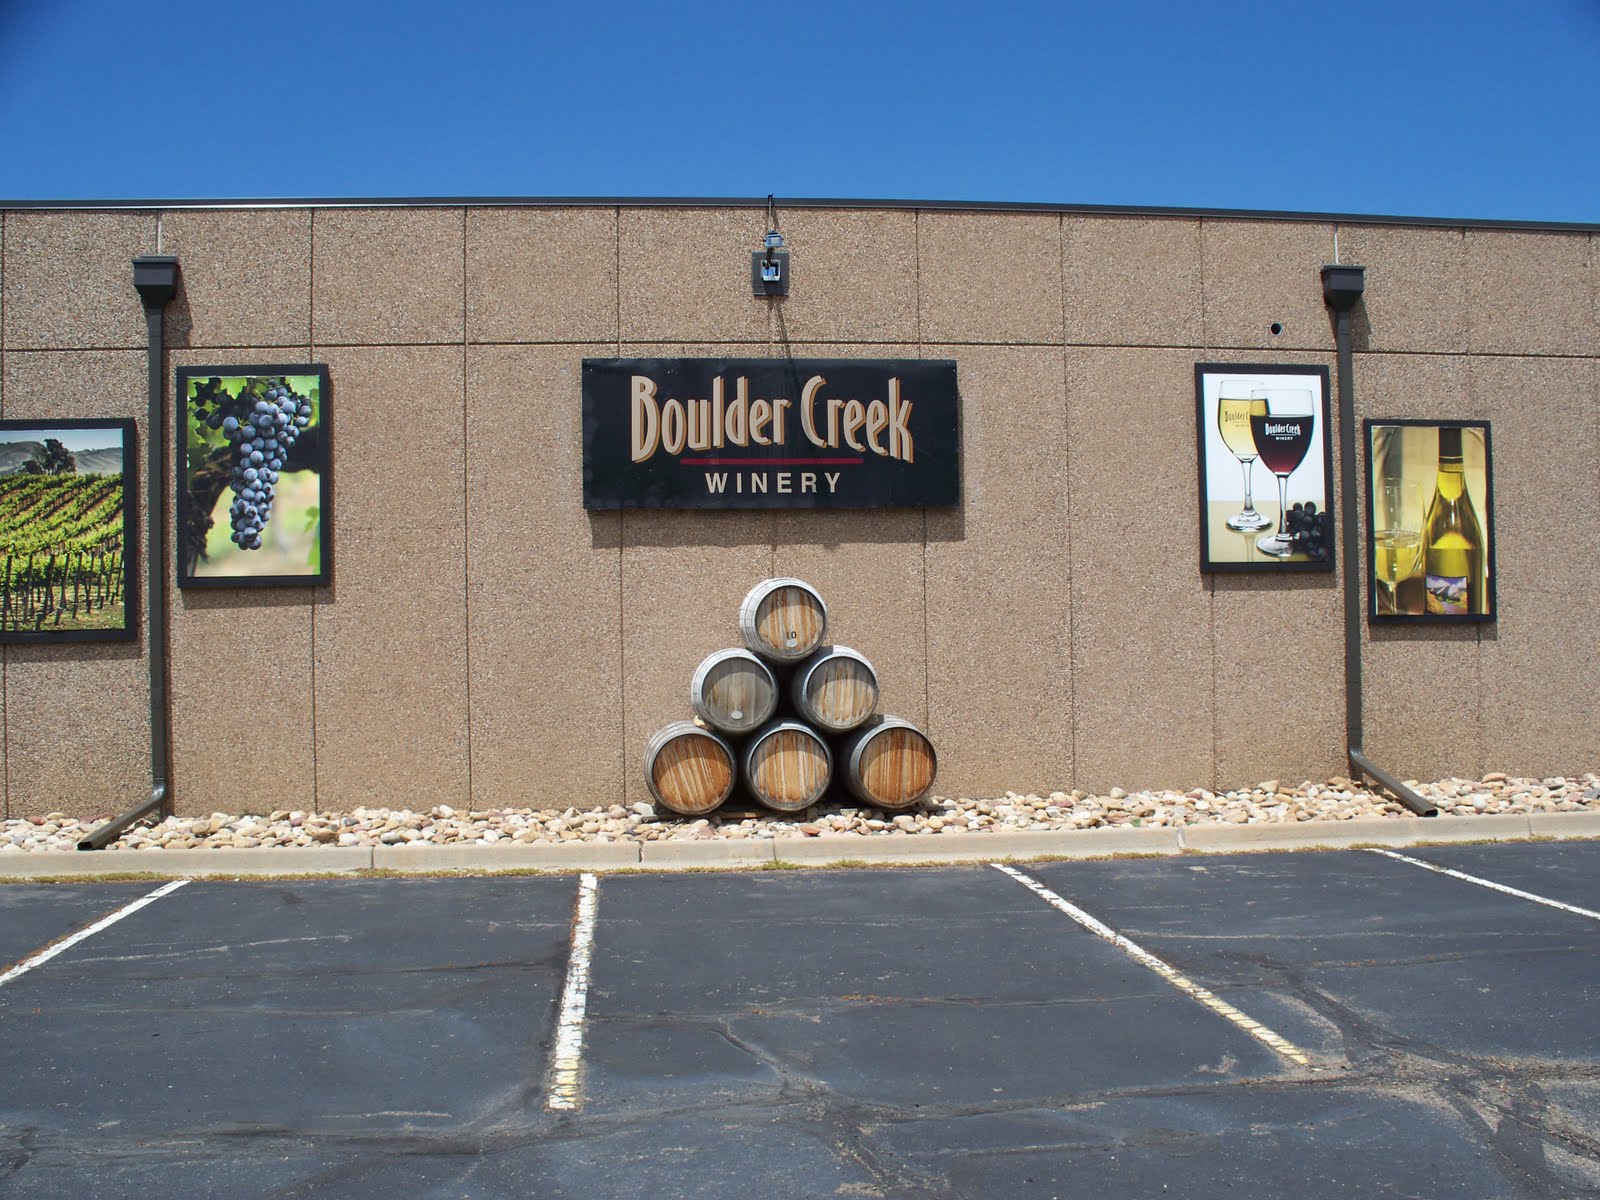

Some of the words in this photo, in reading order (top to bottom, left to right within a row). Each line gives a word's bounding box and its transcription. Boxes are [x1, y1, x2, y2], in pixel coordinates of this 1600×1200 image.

[631, 375, 791, 463] Boulder
[801, 375, 913, 463] Creek
[1265, 423, 1285, 435] Boulder
[1286, 424, 1301, 435] Creek
[705, 473, 840, 493] WINERY
